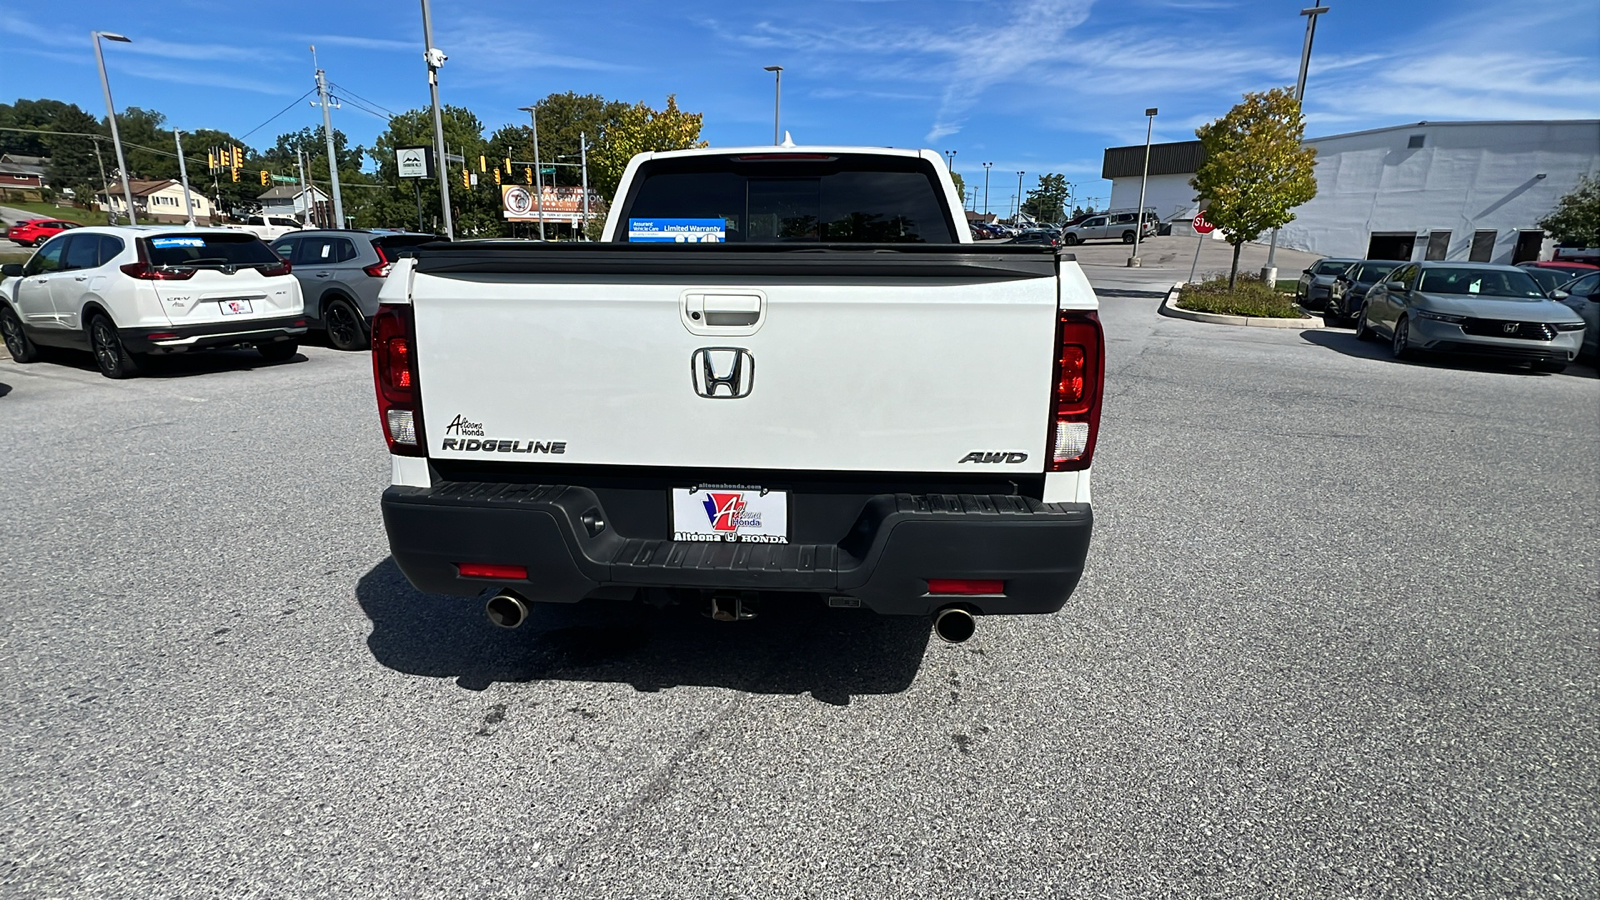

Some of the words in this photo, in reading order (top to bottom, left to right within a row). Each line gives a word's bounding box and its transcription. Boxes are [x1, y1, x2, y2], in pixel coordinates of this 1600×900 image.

[446, 414, 482, 435] Altoona
[442, 438, 567, 454] RIDGELINE
[958, 452, 1028, 463] AWD
[732, 518, 760, 526] Honda
[674, 532, 720, 541] Altoona
[741, 535, 788, 543] HONDA
